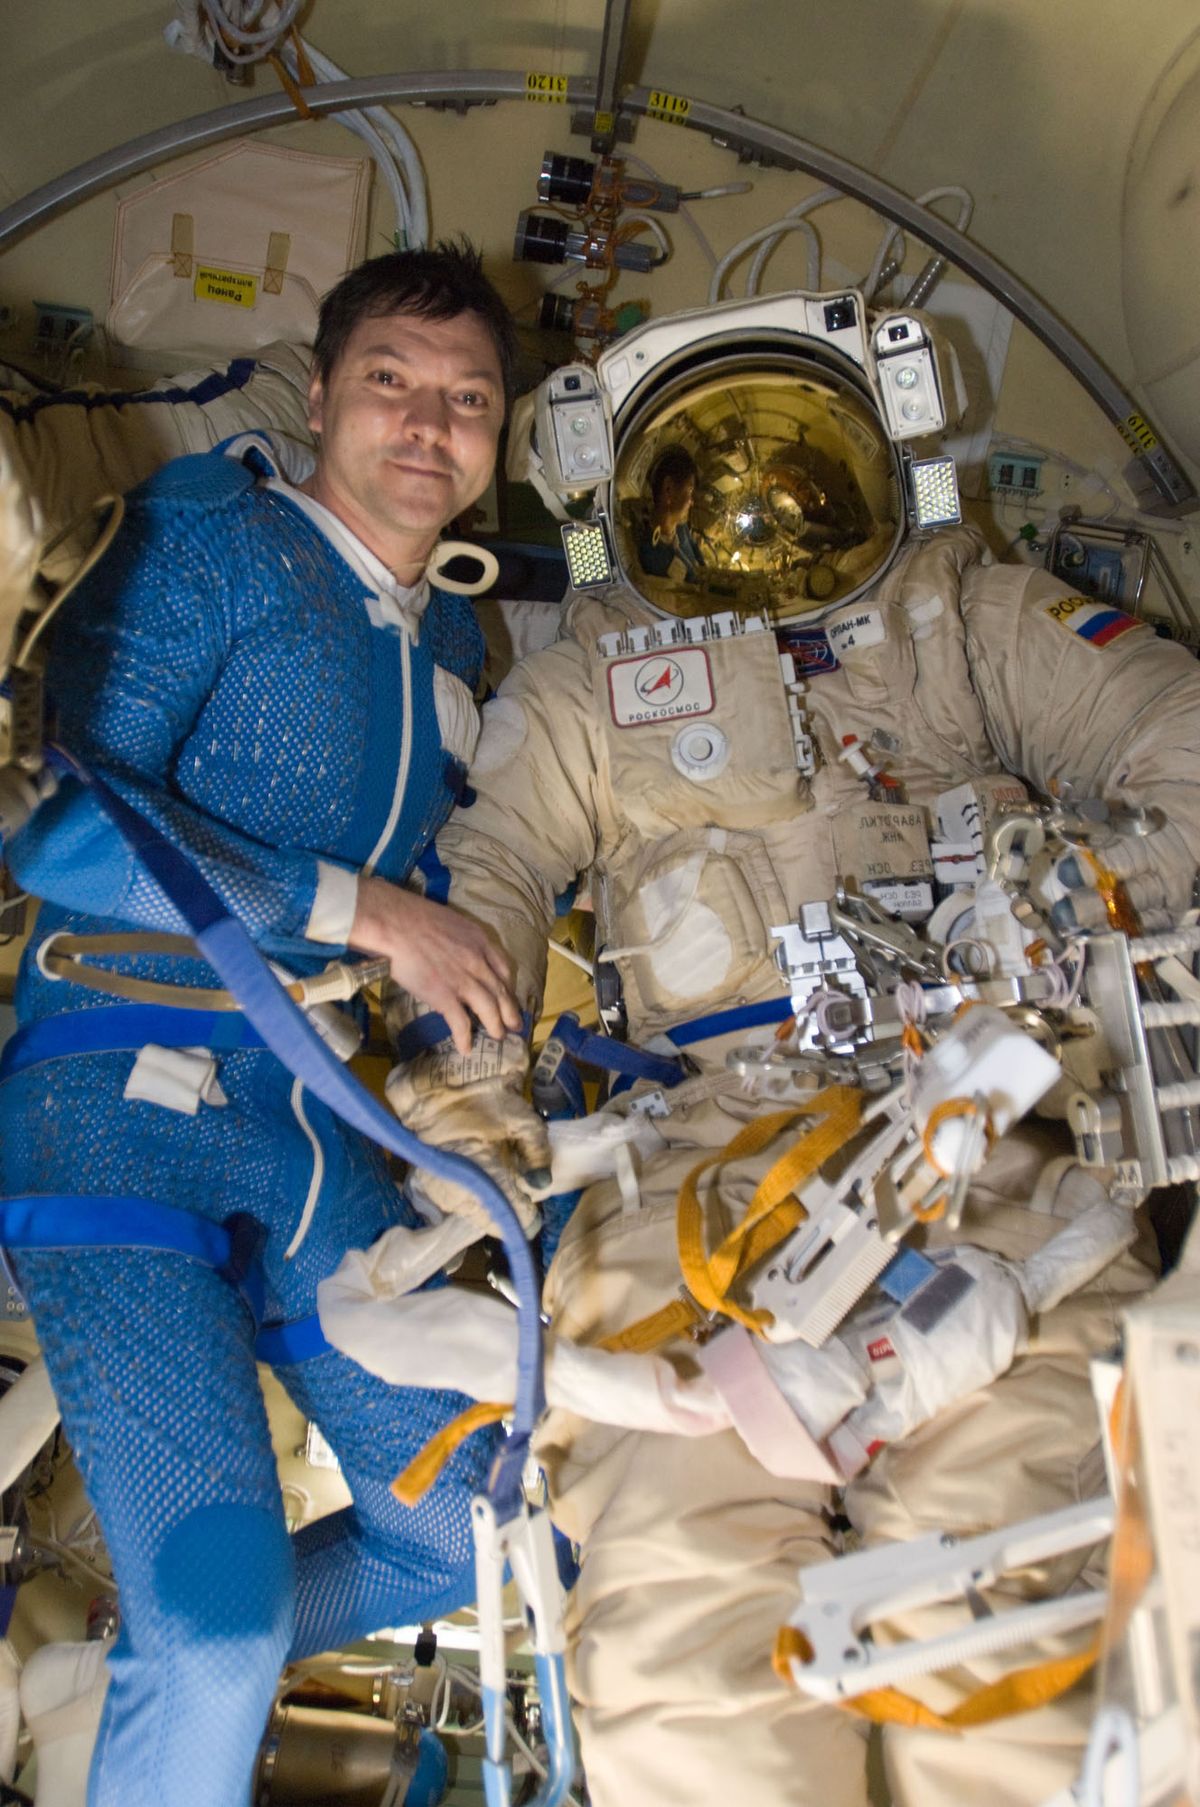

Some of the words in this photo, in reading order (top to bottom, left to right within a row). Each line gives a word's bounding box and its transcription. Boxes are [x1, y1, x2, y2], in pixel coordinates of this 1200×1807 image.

[528, 74, 566, 92] 3120
[651, 92, 689, 113] 3119
[1127, 415, 1157, 449] 3119
[628, 702, 701, 722] РОСКОСМОС
